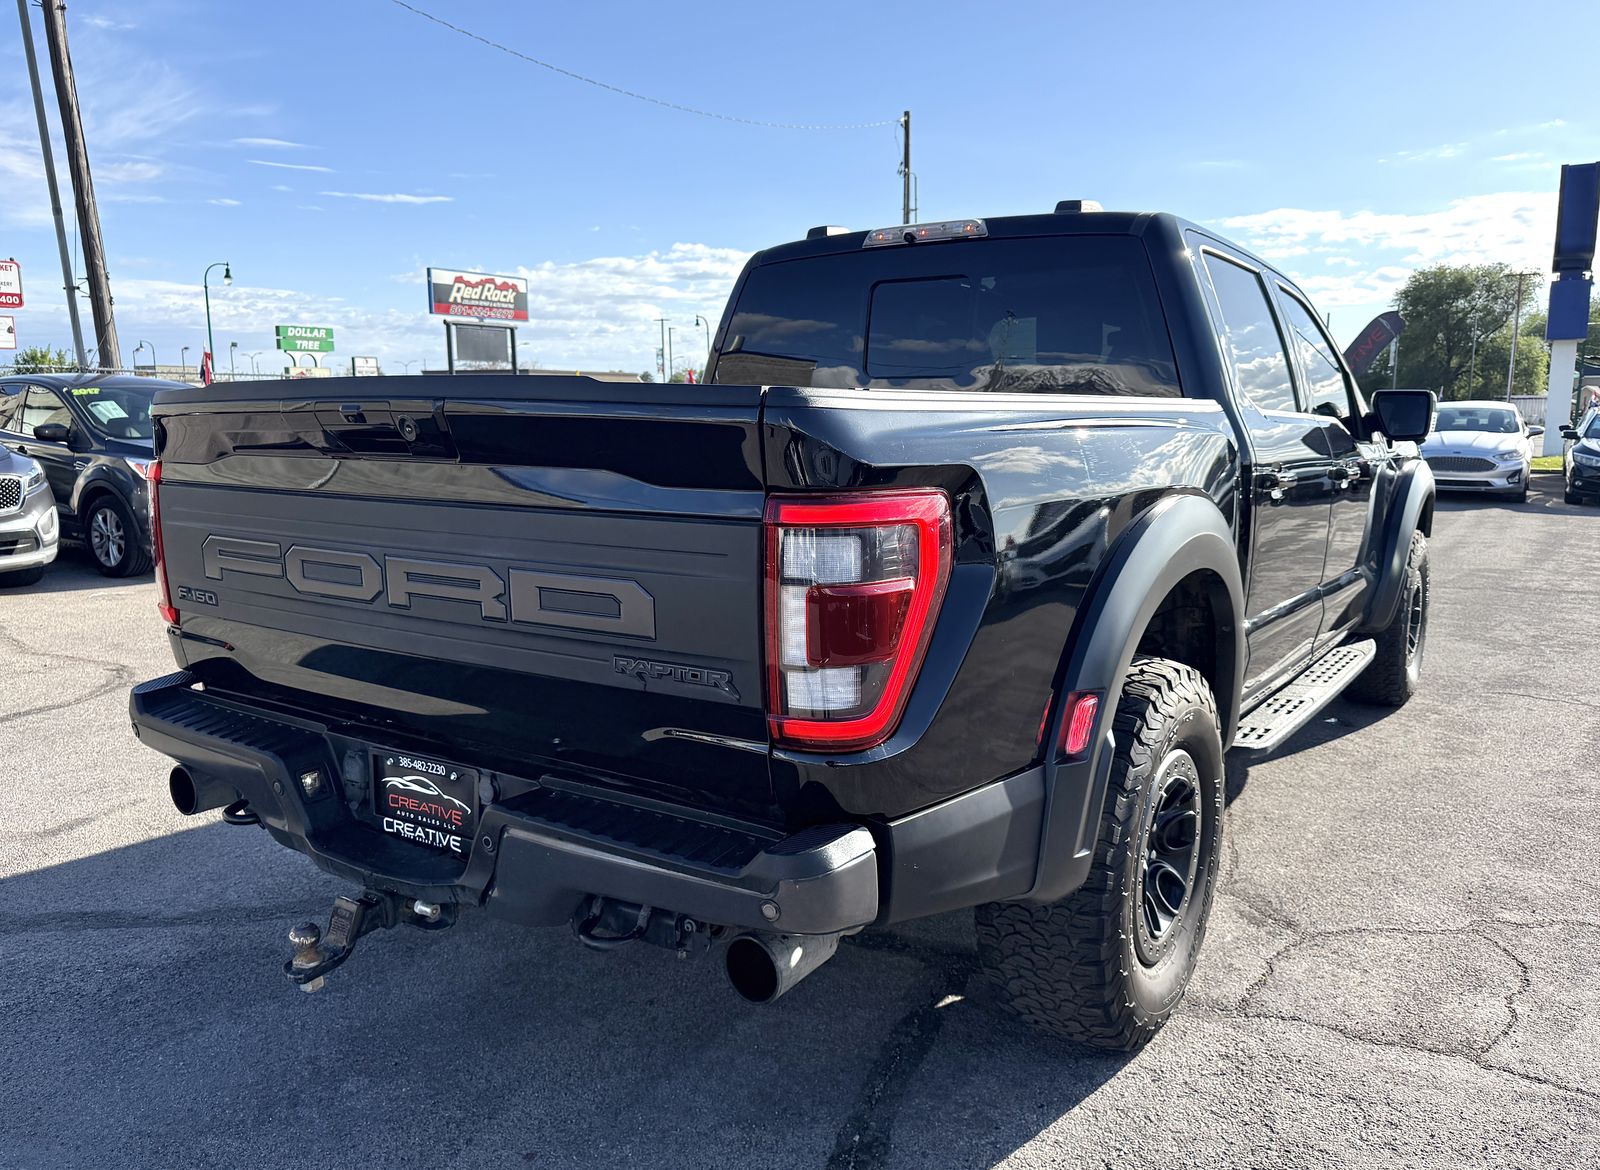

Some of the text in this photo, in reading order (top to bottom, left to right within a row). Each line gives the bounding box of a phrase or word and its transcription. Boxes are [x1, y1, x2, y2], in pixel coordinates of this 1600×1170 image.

[449, 282, 517, 303] Red Rock
[287, 327, 326, 338] DOLLAR
[295, 340, 320, 350] TREE
[178, 585, 219, 607] F-150
[201, 533, 657, 641] FORD
[613, 654, 741, 702] RAPTOR
[398, 756, 446, 776] 385-482-2230
[388, 794, 462, 826] CREATIVE
[396, 810, 456, 830] AUTO SALES LLC
[383, 817, 462, 853] CREATIVE
